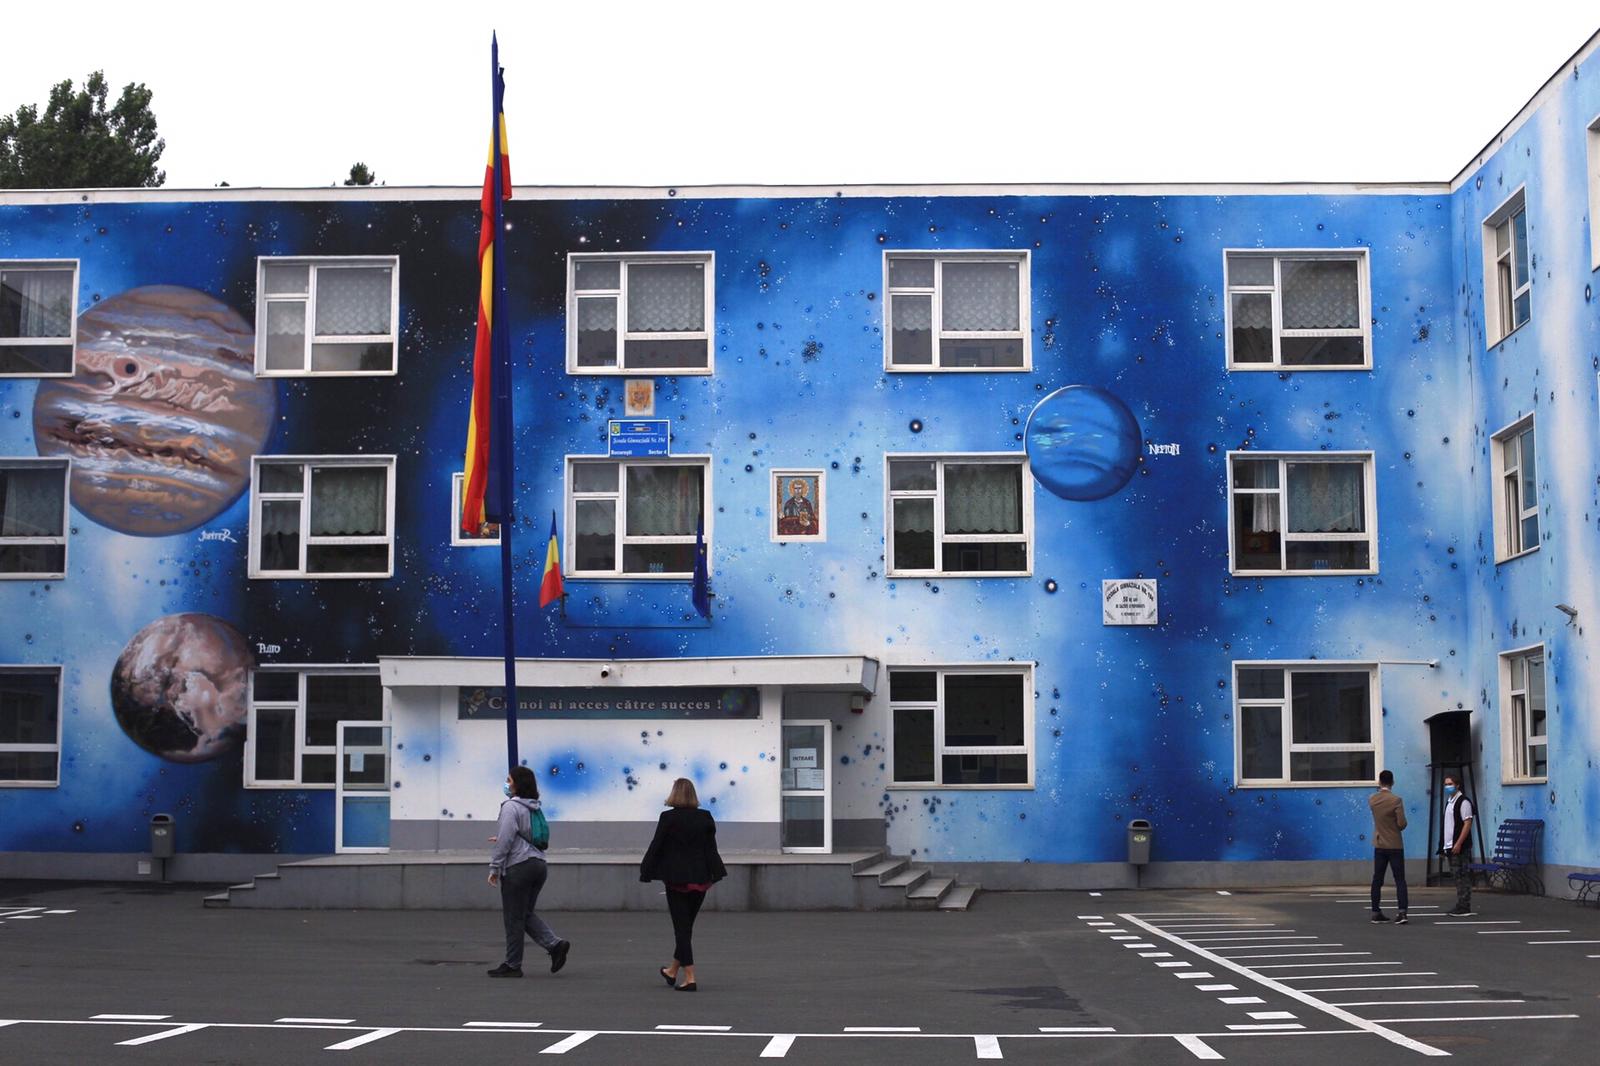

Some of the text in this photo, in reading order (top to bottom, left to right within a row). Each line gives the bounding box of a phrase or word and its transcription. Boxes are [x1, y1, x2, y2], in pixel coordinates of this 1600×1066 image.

[519, 700, 543, 710] noi
[550, 700, 562, 710] ai
[569, 701, 609, 710] acces
[615, 700, 655, 710] către
[661, 701, 711, 710] succes
